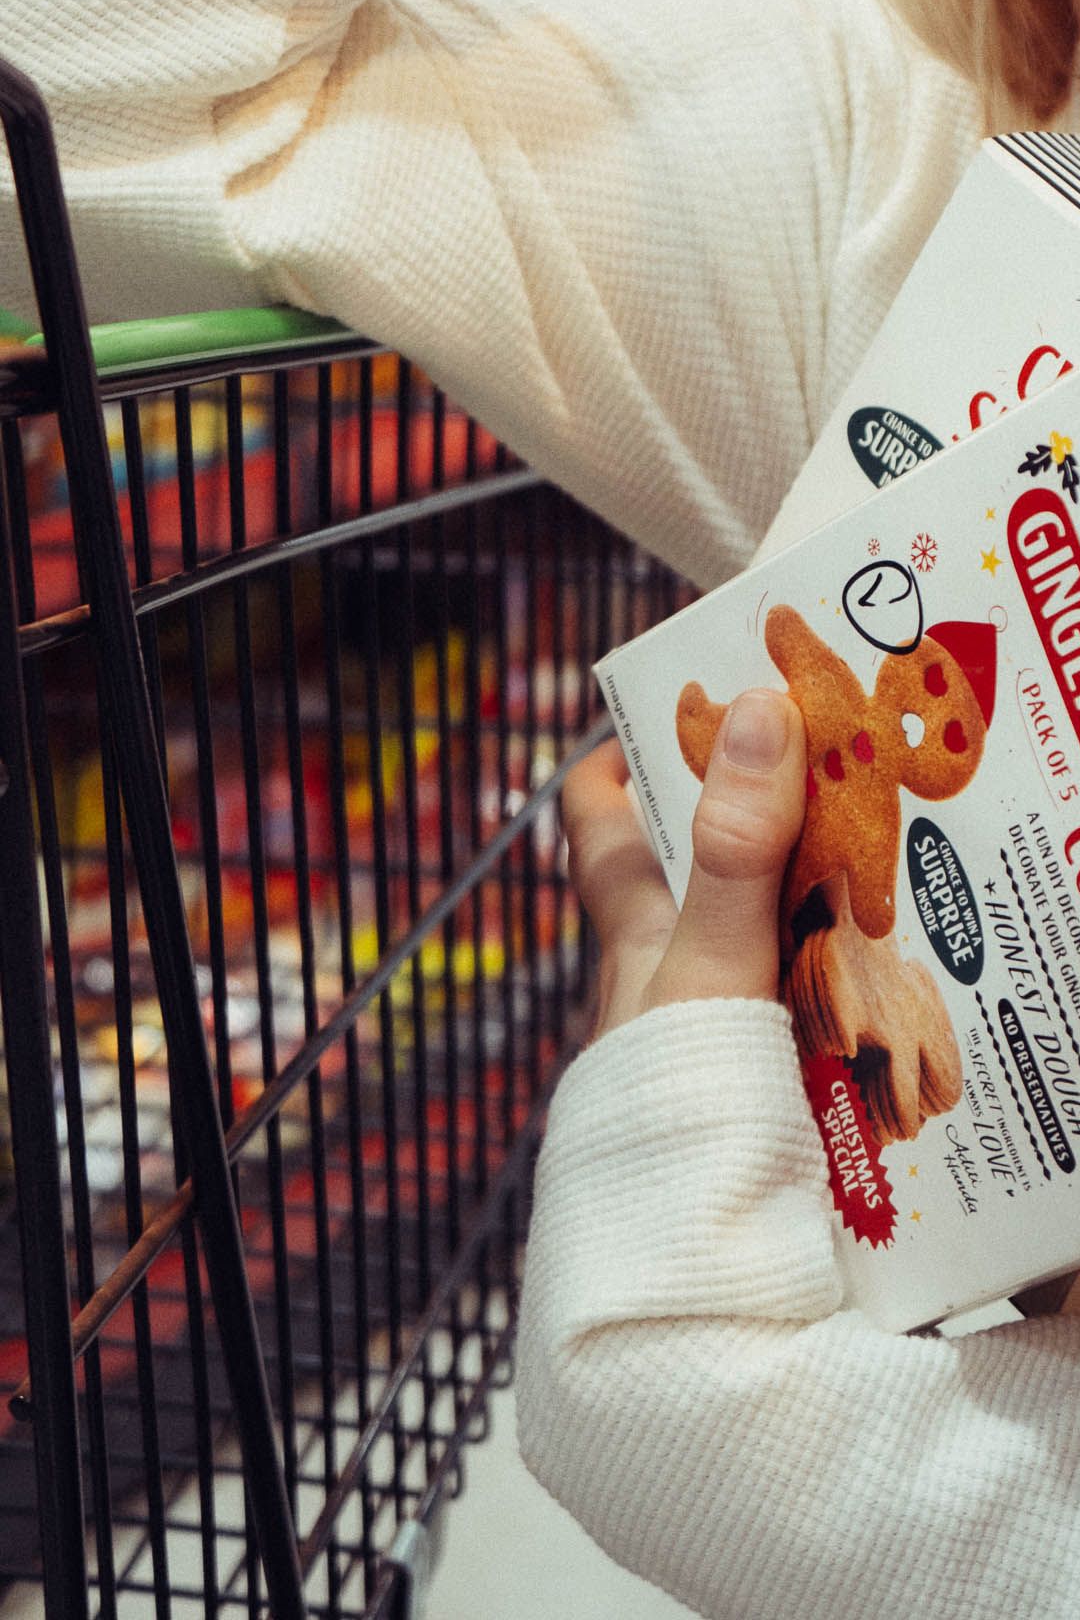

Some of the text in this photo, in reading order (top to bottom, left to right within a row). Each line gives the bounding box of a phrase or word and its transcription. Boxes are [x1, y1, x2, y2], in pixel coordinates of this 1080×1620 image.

[857, 420, 919, 476] SURP
[882, 411, 933, 457] CHANCE TO
[622, 721, 635, 744] for
[630, 746, 663, 825] illustration
[1026, 812, 1040, 825] A
[1047, 750, 1071, 778] OF
[1059, 784, 1078, 801] 5
[938, 840, 982, 947] CHANCE TO WIN A
[1008, 824, 1050, 911] DECORATE
[1041, 912, 1068, 960] YOUR
[1032, 826, 1053, 859] FUN
[1045, 861, 1066, 890] DIY
[914, 835, 976, 967] SURPRISE
[915, 886, 940, 935] INSIDE
[984, 901, 1051, 1020] HONEST
[965, 1079, 1017, 1183] ALWAYS LOVE
[968, 1028, 1033, 1192] THE SECRET INGREDIENT IS
[1001, 1012, 1070, 1162] NO PRESERVATIVES
[821, 1107, 859, 1197] SPECIAL
[830, 1080, 883, 1210] CHRISTMAS
